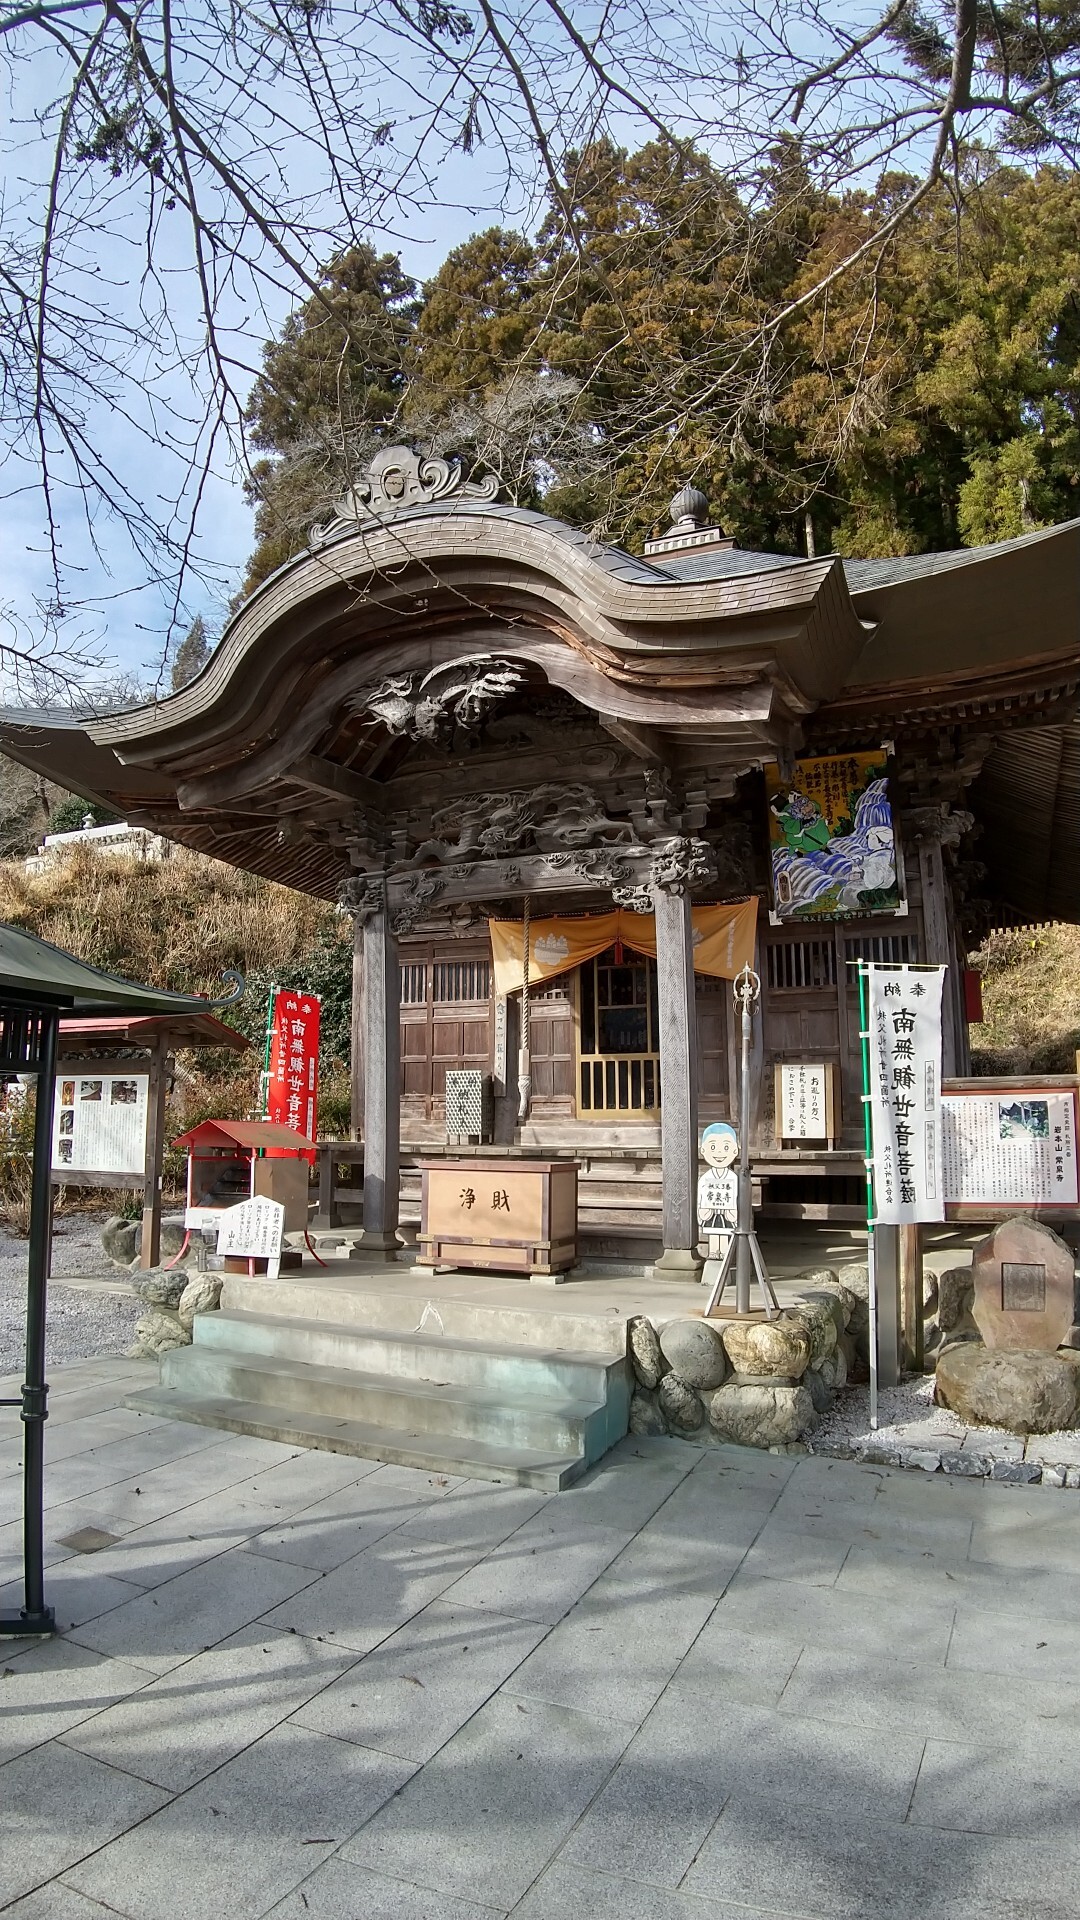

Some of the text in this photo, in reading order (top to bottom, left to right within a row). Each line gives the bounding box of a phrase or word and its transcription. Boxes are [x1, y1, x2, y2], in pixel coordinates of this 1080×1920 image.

[1054, 1126, 1065, 1182] 岩本山 常泉寺
[459, 1187, 511, 1212] 浄財
[707, 1191, 732, 1203] 常泉寺
